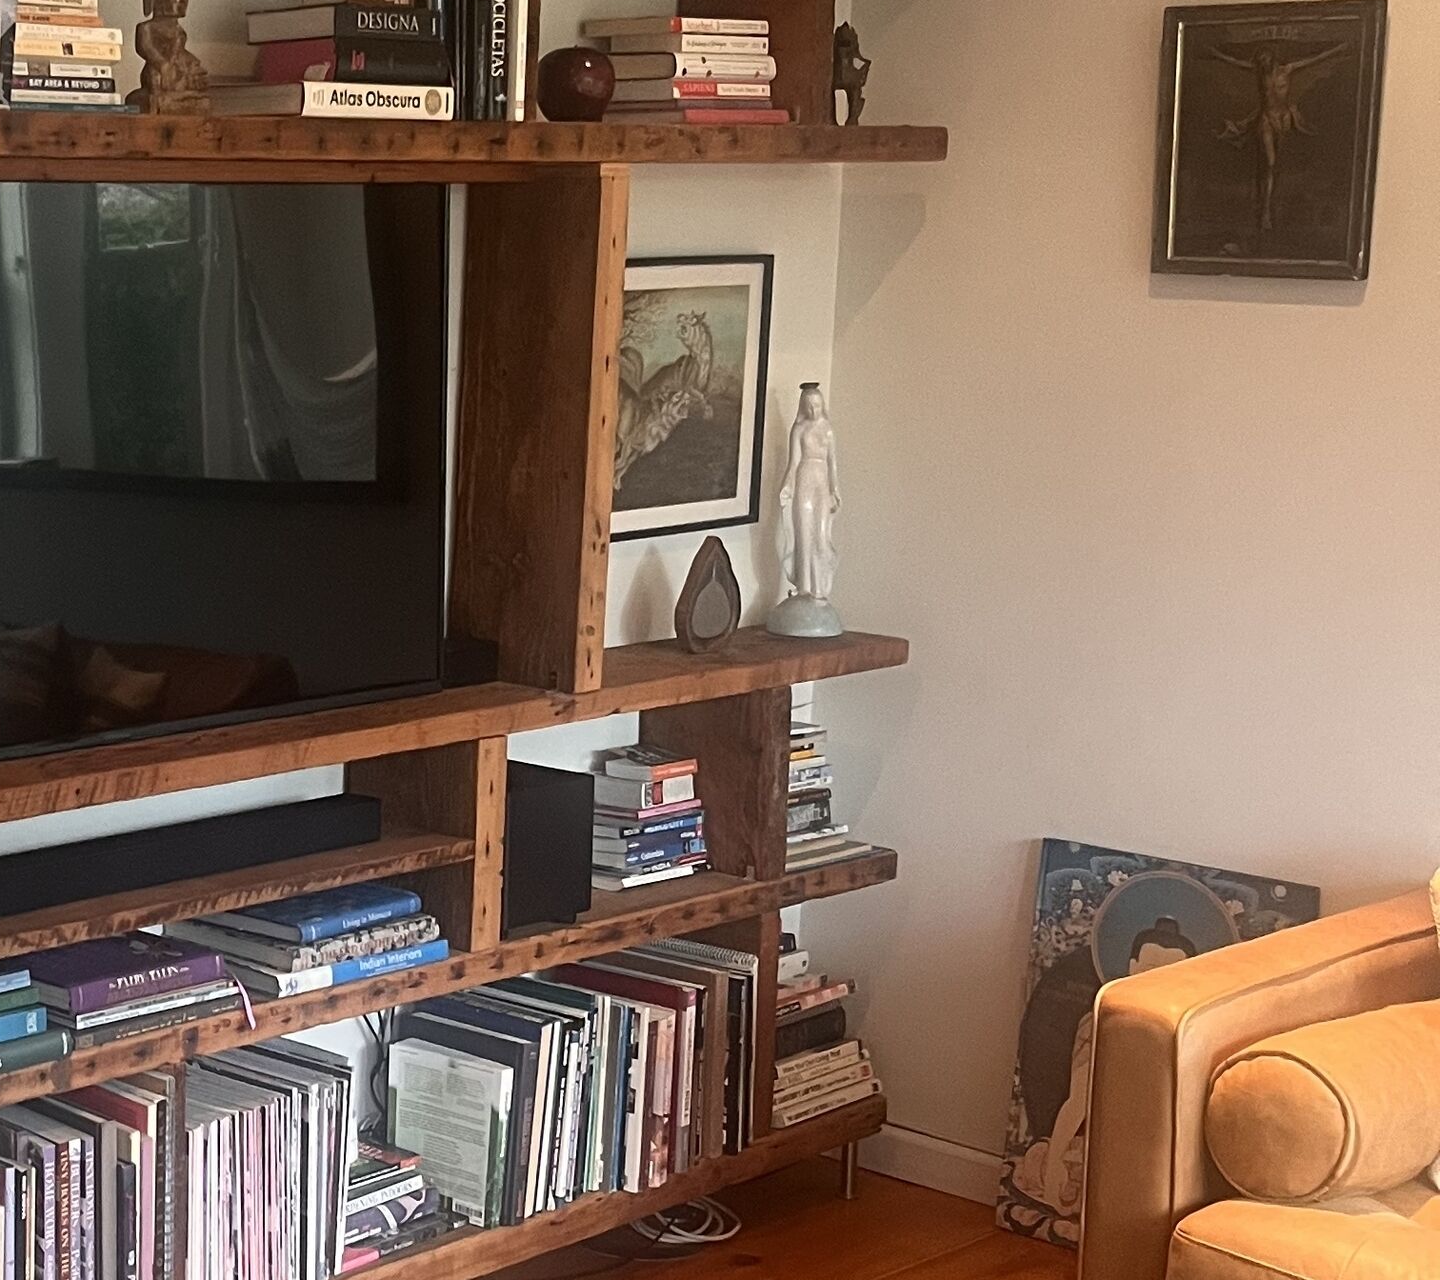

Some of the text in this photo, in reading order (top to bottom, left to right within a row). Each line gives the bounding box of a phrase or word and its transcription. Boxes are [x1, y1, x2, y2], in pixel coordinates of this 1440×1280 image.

[357, 10, 419, 32] DESIGNA
[29, 79, 43, 87] BAY
[44, 79, 63, 88] AREA
[71, 80, 100, 89] BEYOND
[329, 88, 421, 109] Atlas Obscura
[360, 949, 423, 971] Indian Interiors
[60, 1150, 70, 1178] TINY
[86, 1150, 94, 1180] TINY
[44, 1161, 55, 1201] HOME
[71, 1163, 80, 1227] BUILDERS
[60, 1182, 70, 1226] HOMES
[85, 1184, 94, 1229] HOMES
[44, 1202, 56, 1250] WORK
[61, 1227, 70, 1247] ON
[61, 1249, 70, 1276] THE
